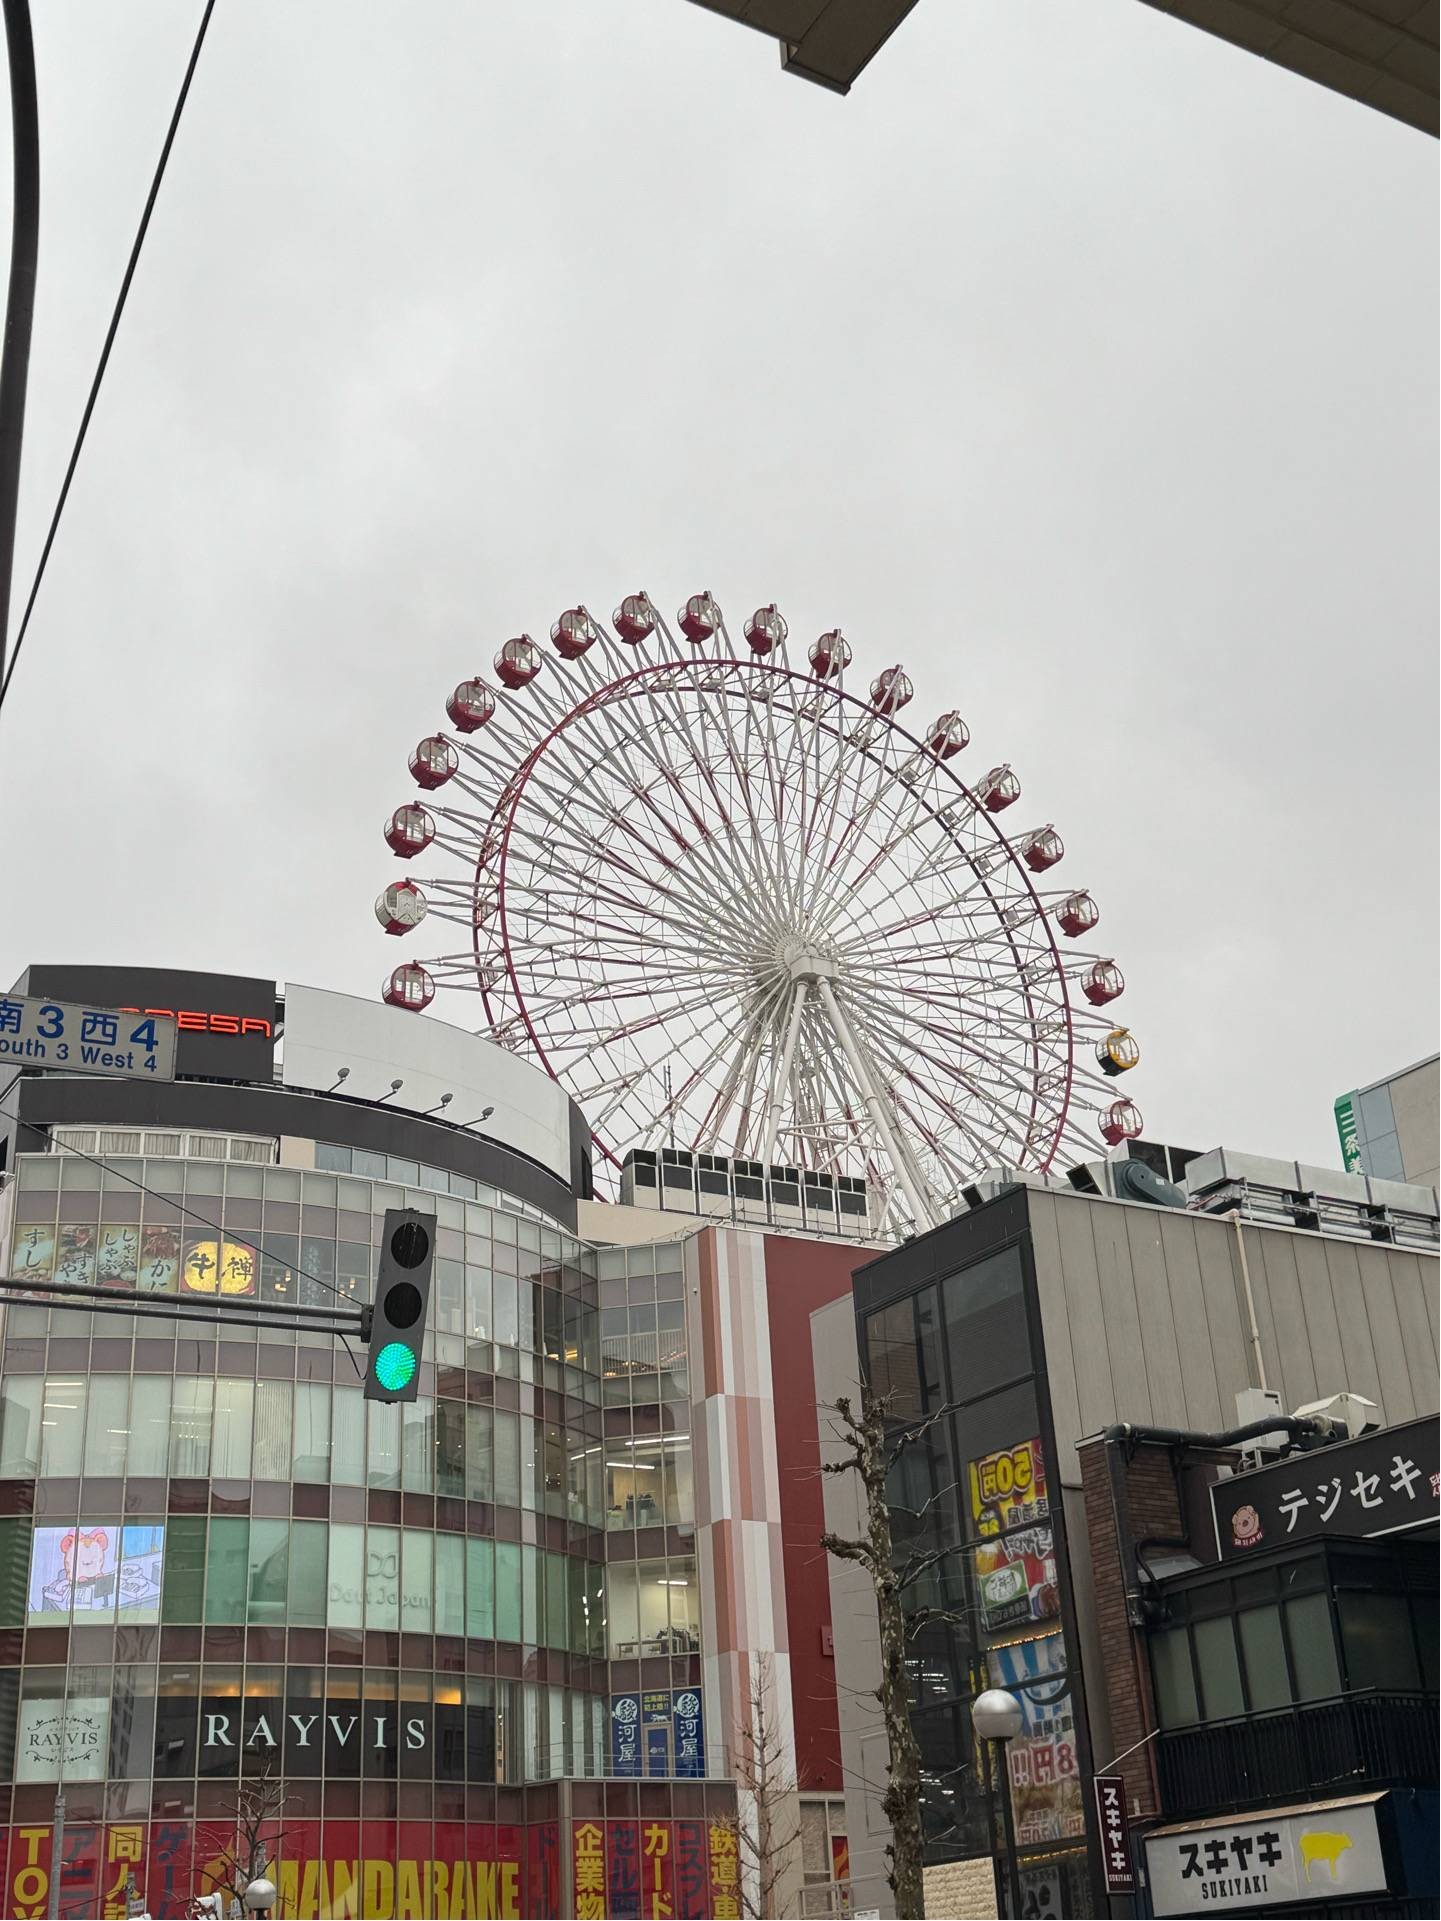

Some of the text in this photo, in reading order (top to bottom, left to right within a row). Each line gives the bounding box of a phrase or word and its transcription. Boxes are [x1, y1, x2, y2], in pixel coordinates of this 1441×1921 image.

[0, 1037, 157, 1072] outh 3 West 4
[24, 1228, 46, 1268] すし
[1278, 1456, 1422, 1533] テジセキ
[29, 1731, 98, 1747] RAYVIS
[203, 1714, 426, 1750] RAYVIS
[1103, 1787, 1127, 1871] スキヤキ
[575, 1823, 605, 1919] 企業物
[644, 1823, 673, 1919] カード
[1179, 1831, 1283, 1879] スキヤキ
[262, 1860, 519, 1919] MANDARAKE
[1202, 1875, 1268, 1899] SUKIYAKI
